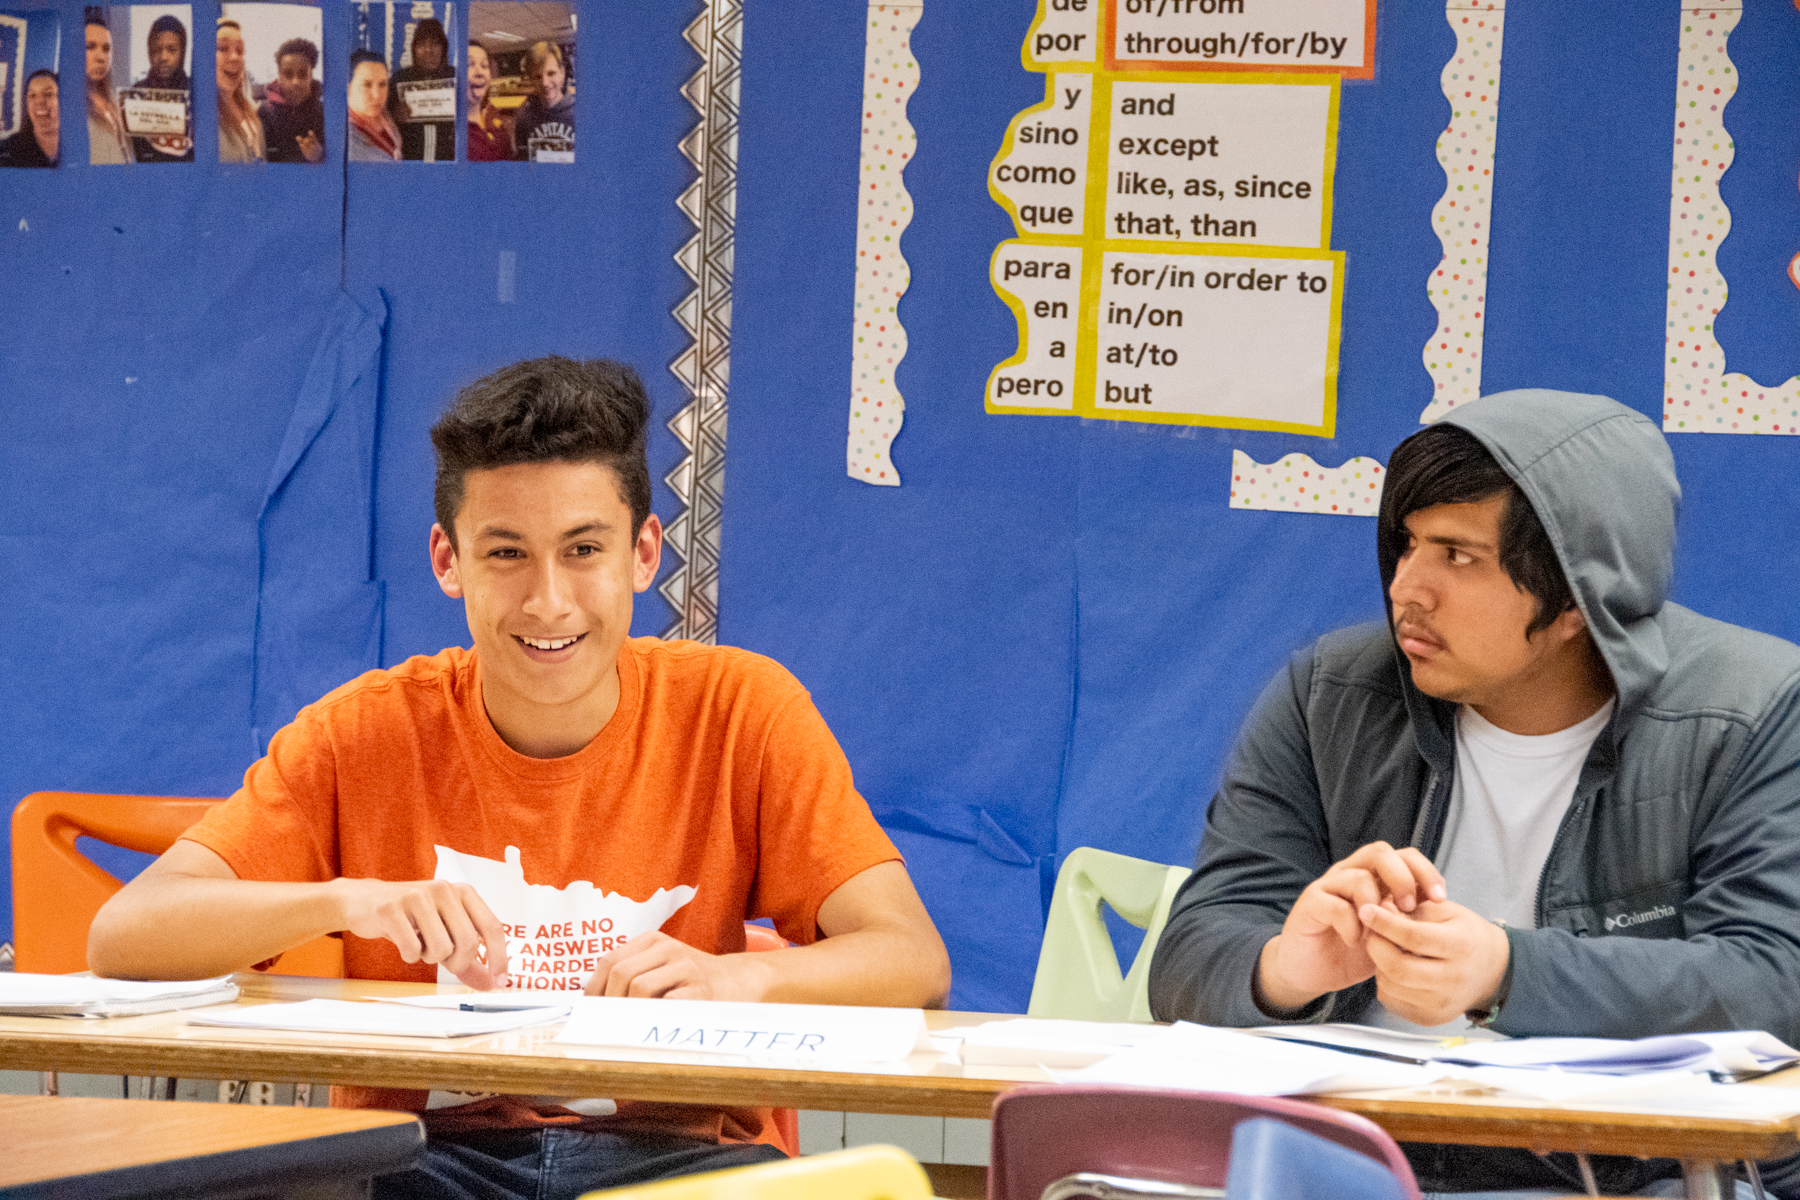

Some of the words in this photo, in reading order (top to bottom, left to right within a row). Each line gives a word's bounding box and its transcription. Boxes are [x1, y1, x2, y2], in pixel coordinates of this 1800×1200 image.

[1052, 0, 1088, 12] de
[1125, 0, 1244, 17] of/from
[1036, 33, 1086, 56] por
[1124, 31, 1347, 59] through/for/by
[1064, 88, 1081, 110] y
[1121, 93, 1175, 116] and
[1019, 122, 1079, 146] sino
[1118, 135, 1219, 161] except
[996, 165, 1076, 185] como
[1117, 171, 1174, 199] like,
[1183, 178, 1224, 200] as,
[1234, 175, 1312, 199] since
[1020, 205, 1074, 227] que
[1114, 211, 1181, 239] that,
[1190, 213, 1257, 237] than
[1004, 257, 1071, 281] para
[1111, 262, 1195, 290] for/in
[1204, 267, 1288, 292] order
[1297, 271, 1327, 294] to
[1034, 300, 1068, 319] en
[1108, 303, 1183, 329] in/on
[1049, 340, 1065, 358] a
[1106, 342, 1178, 368] at/to
[997, 377, 1064, 398] pero
[1105, 380, 1152, 405] but
[1615, 904, 1677, 928] Columbia
[534, 922, 574, 939] ARE
[581, 917, 614, 936] NO
[519, 935, 628, 958] ANSWERS
[521, 957, 600, 974] HARDE
[642, 1026, 826, 1052] MATTER
